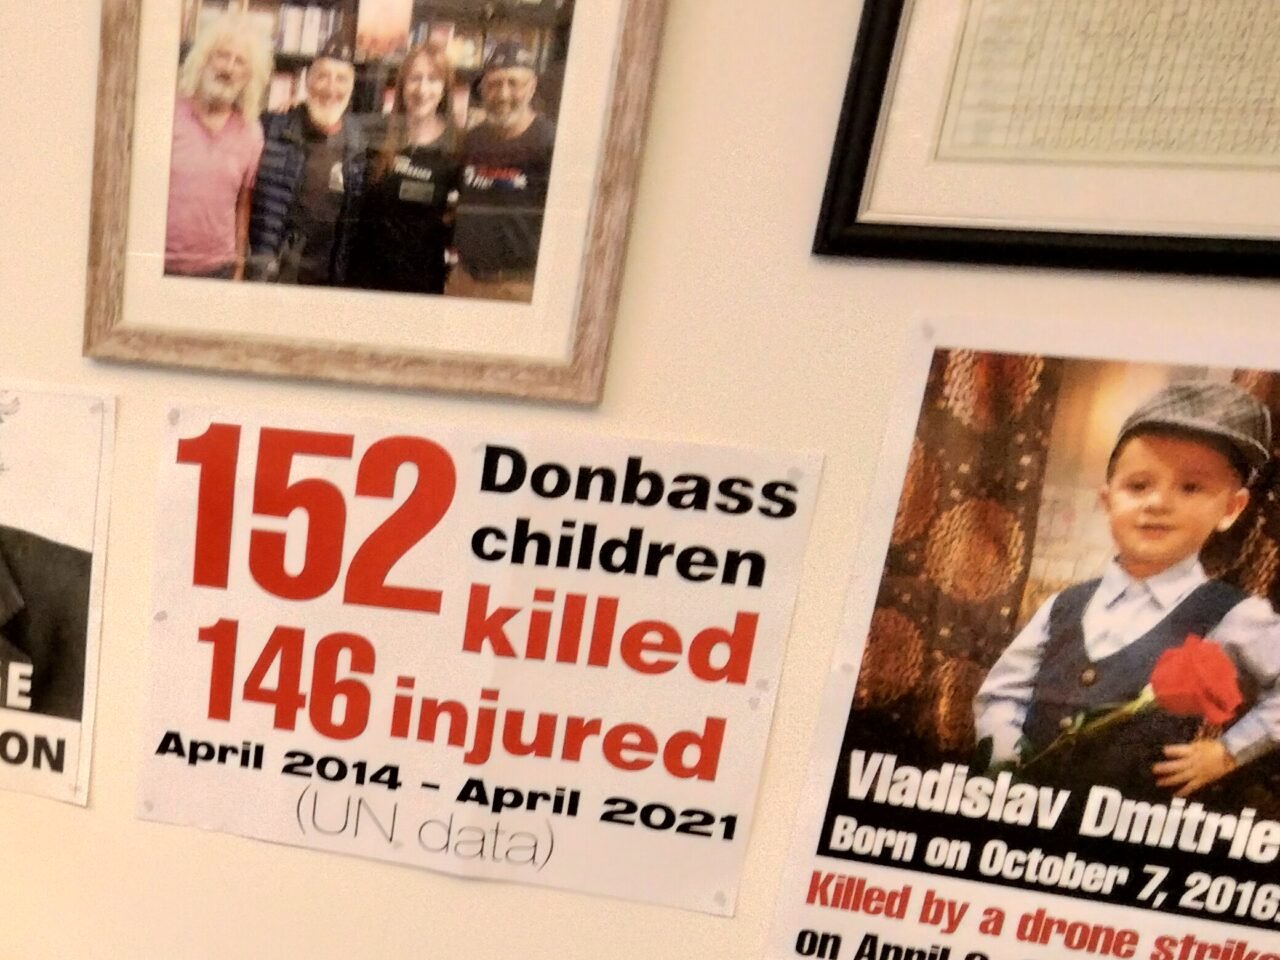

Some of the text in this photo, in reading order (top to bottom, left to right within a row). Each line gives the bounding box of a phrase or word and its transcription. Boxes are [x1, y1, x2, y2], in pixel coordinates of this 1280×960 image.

[176, 422, 457, 615] 152
[480, 444, 799, 519] Donbass
[471, 517, 766, 588] children
[463, 583, 759, 685] killed
[197, 618, 727, 782] 146 injured
[155, 731, 264, 770] April
[281, 750, 402, 791] 2014
[455, 778, 581, 817] April
[599, 797, 738, 841] 2021
[296, 784, 555, 872] (UN data)
[847, 749, 1280, 864] Vladislav Dmitrie
[829, 814, 918, 862] Born
[925, 836, 972, 871] on
[978, 838, 1131, 895] October
[1137, 864, 1171, 908] 7,
[805, 870, 912, 920] Killed
[919, 889, 969, 934] by
[978, 908, 1006, 936] a
[1015, 908, 1139, 959] drone
